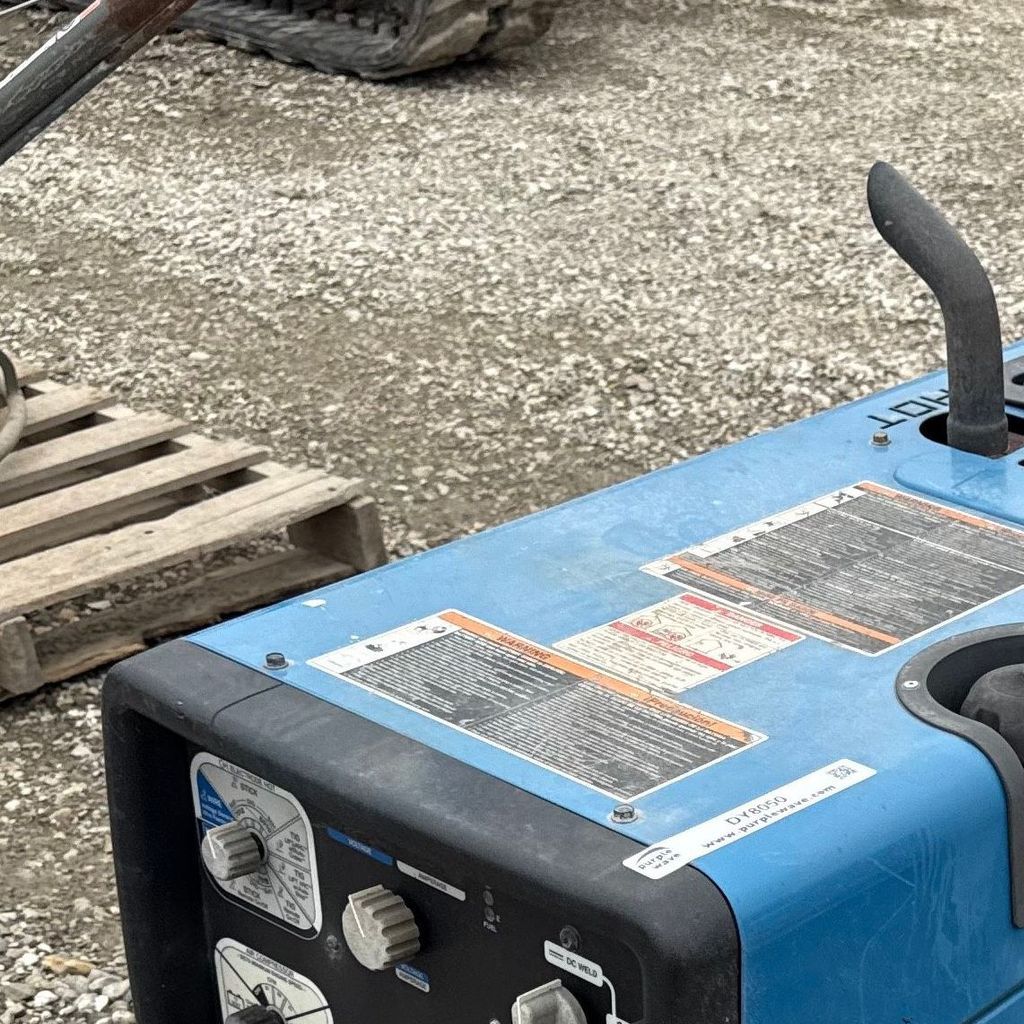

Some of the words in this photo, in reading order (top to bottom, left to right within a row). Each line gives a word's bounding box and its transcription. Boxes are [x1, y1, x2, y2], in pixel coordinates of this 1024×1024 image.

[496, 634, 551, 661] WARNING
[701, 784, 836, 849] www.purplewave.com
[725, 795, 788, 827] DY8050
[637, 848, 673, 871] purple
[652, 853, 682, 870] wave
[566, 956, 577, 969] DC
[578, 961, 598, 978] WELD
